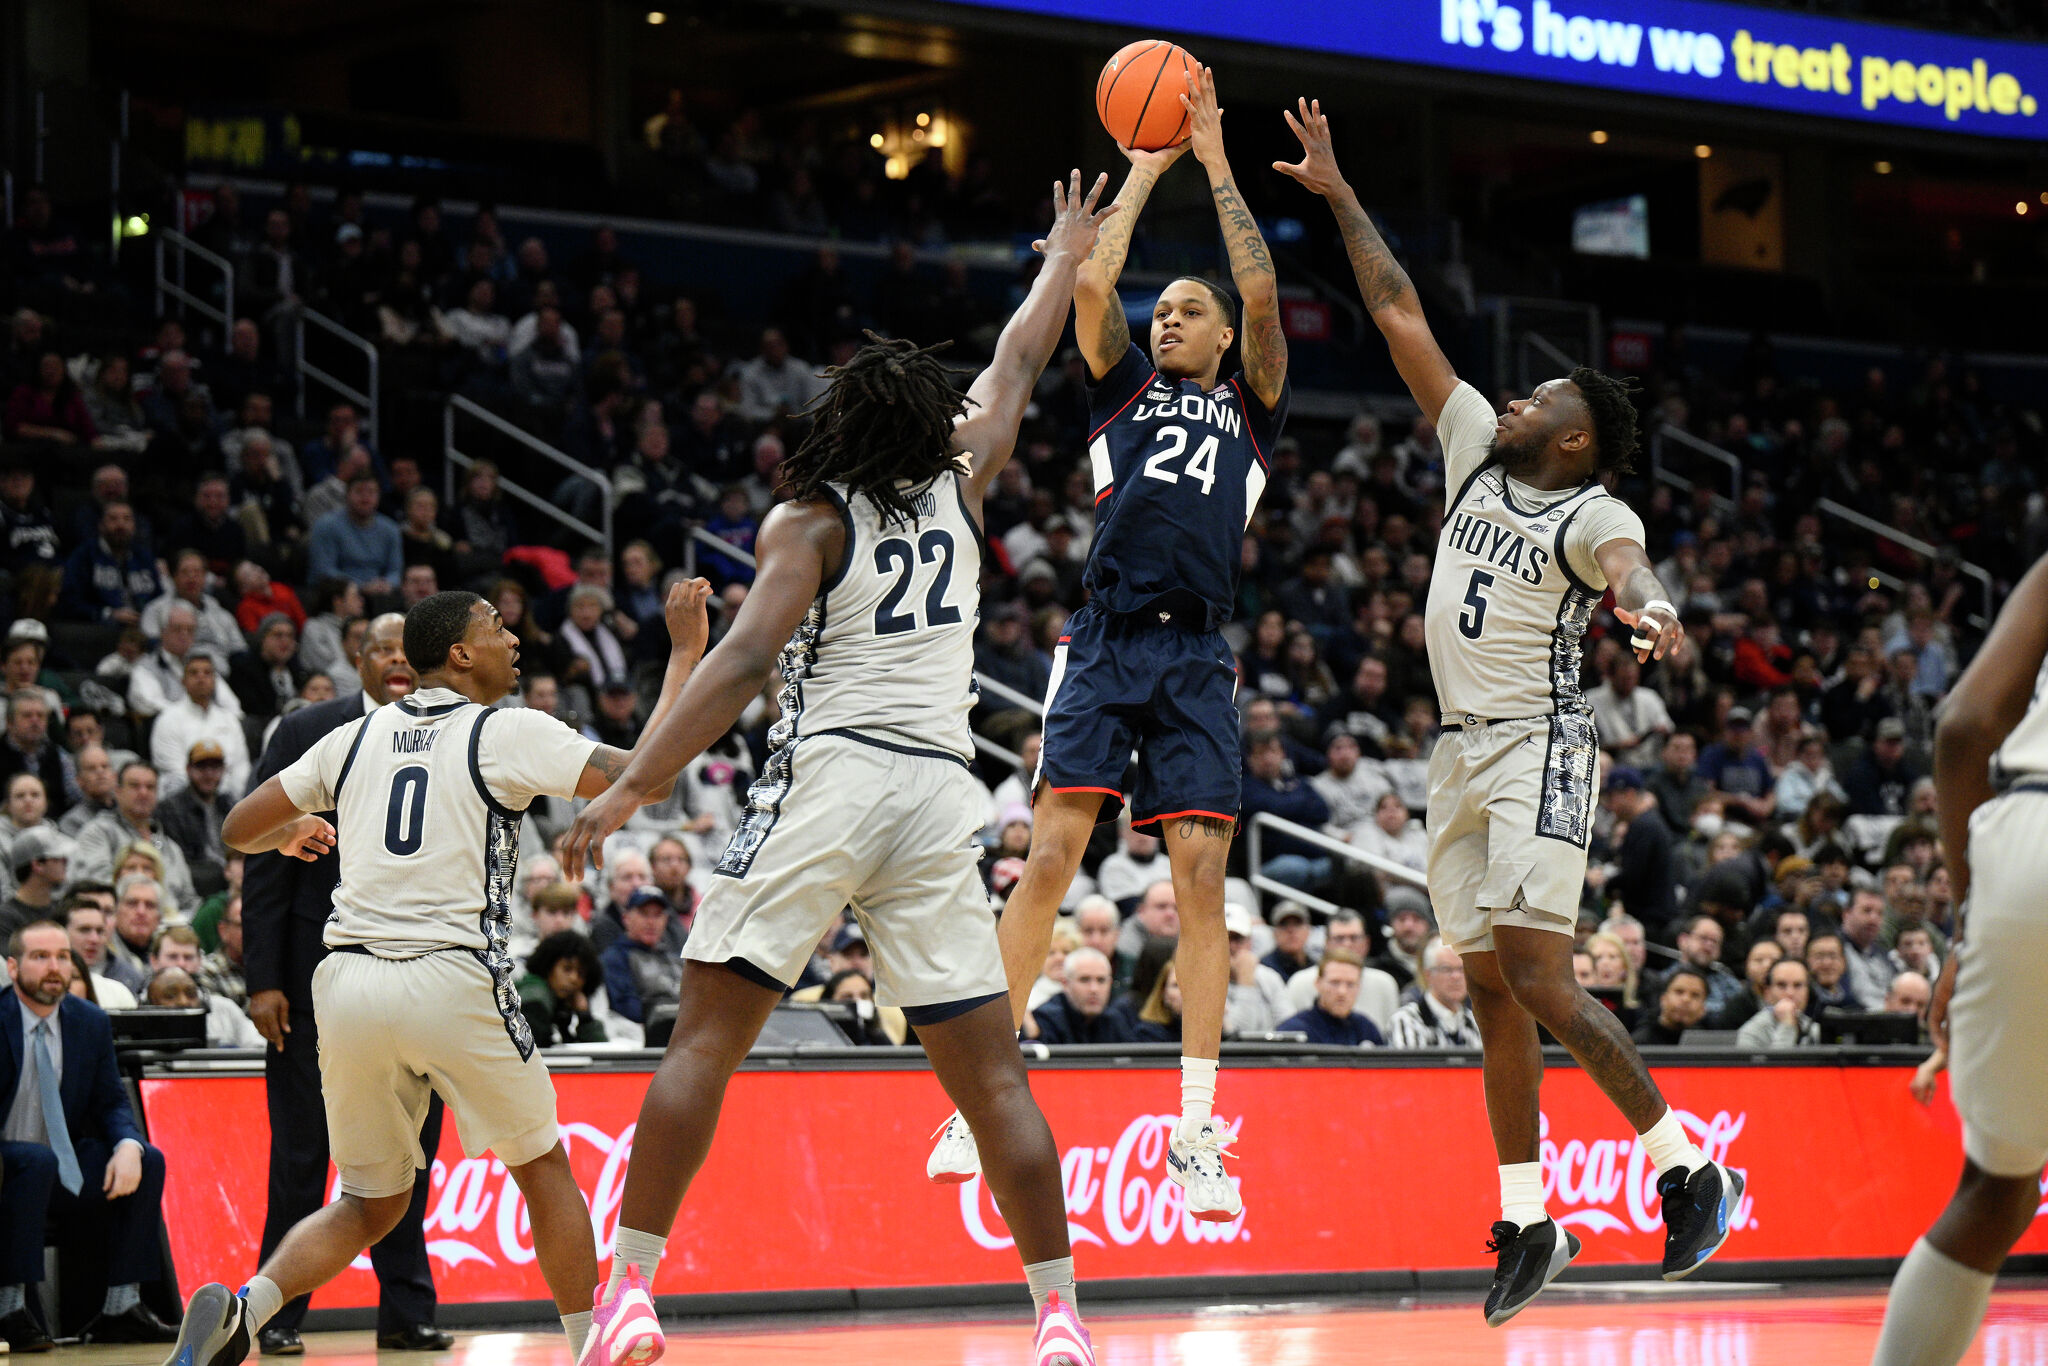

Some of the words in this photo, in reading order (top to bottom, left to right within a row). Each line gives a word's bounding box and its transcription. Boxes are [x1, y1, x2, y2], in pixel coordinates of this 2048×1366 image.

[1440, 0, 1523, 52] It's
[1533, 0, 1642, 67] how
[1649, 26, 1725, 78] we
[1732, 29, 1853, 95] treat
[1861, 57, 2038, 121] people.
[1213, 178, 1254, 232] FEAR
[1143, 426, 1219, 495] 24
[873, 529, 963, 636] 22
[1448, 512, 1549, 585] HOYAS
[1458, 569, 1495, 640] 5
[393, 729, 440, 753] MURRAY
[1465, 713, 1478, 725] G
[384, 765, 430, 858] 0
